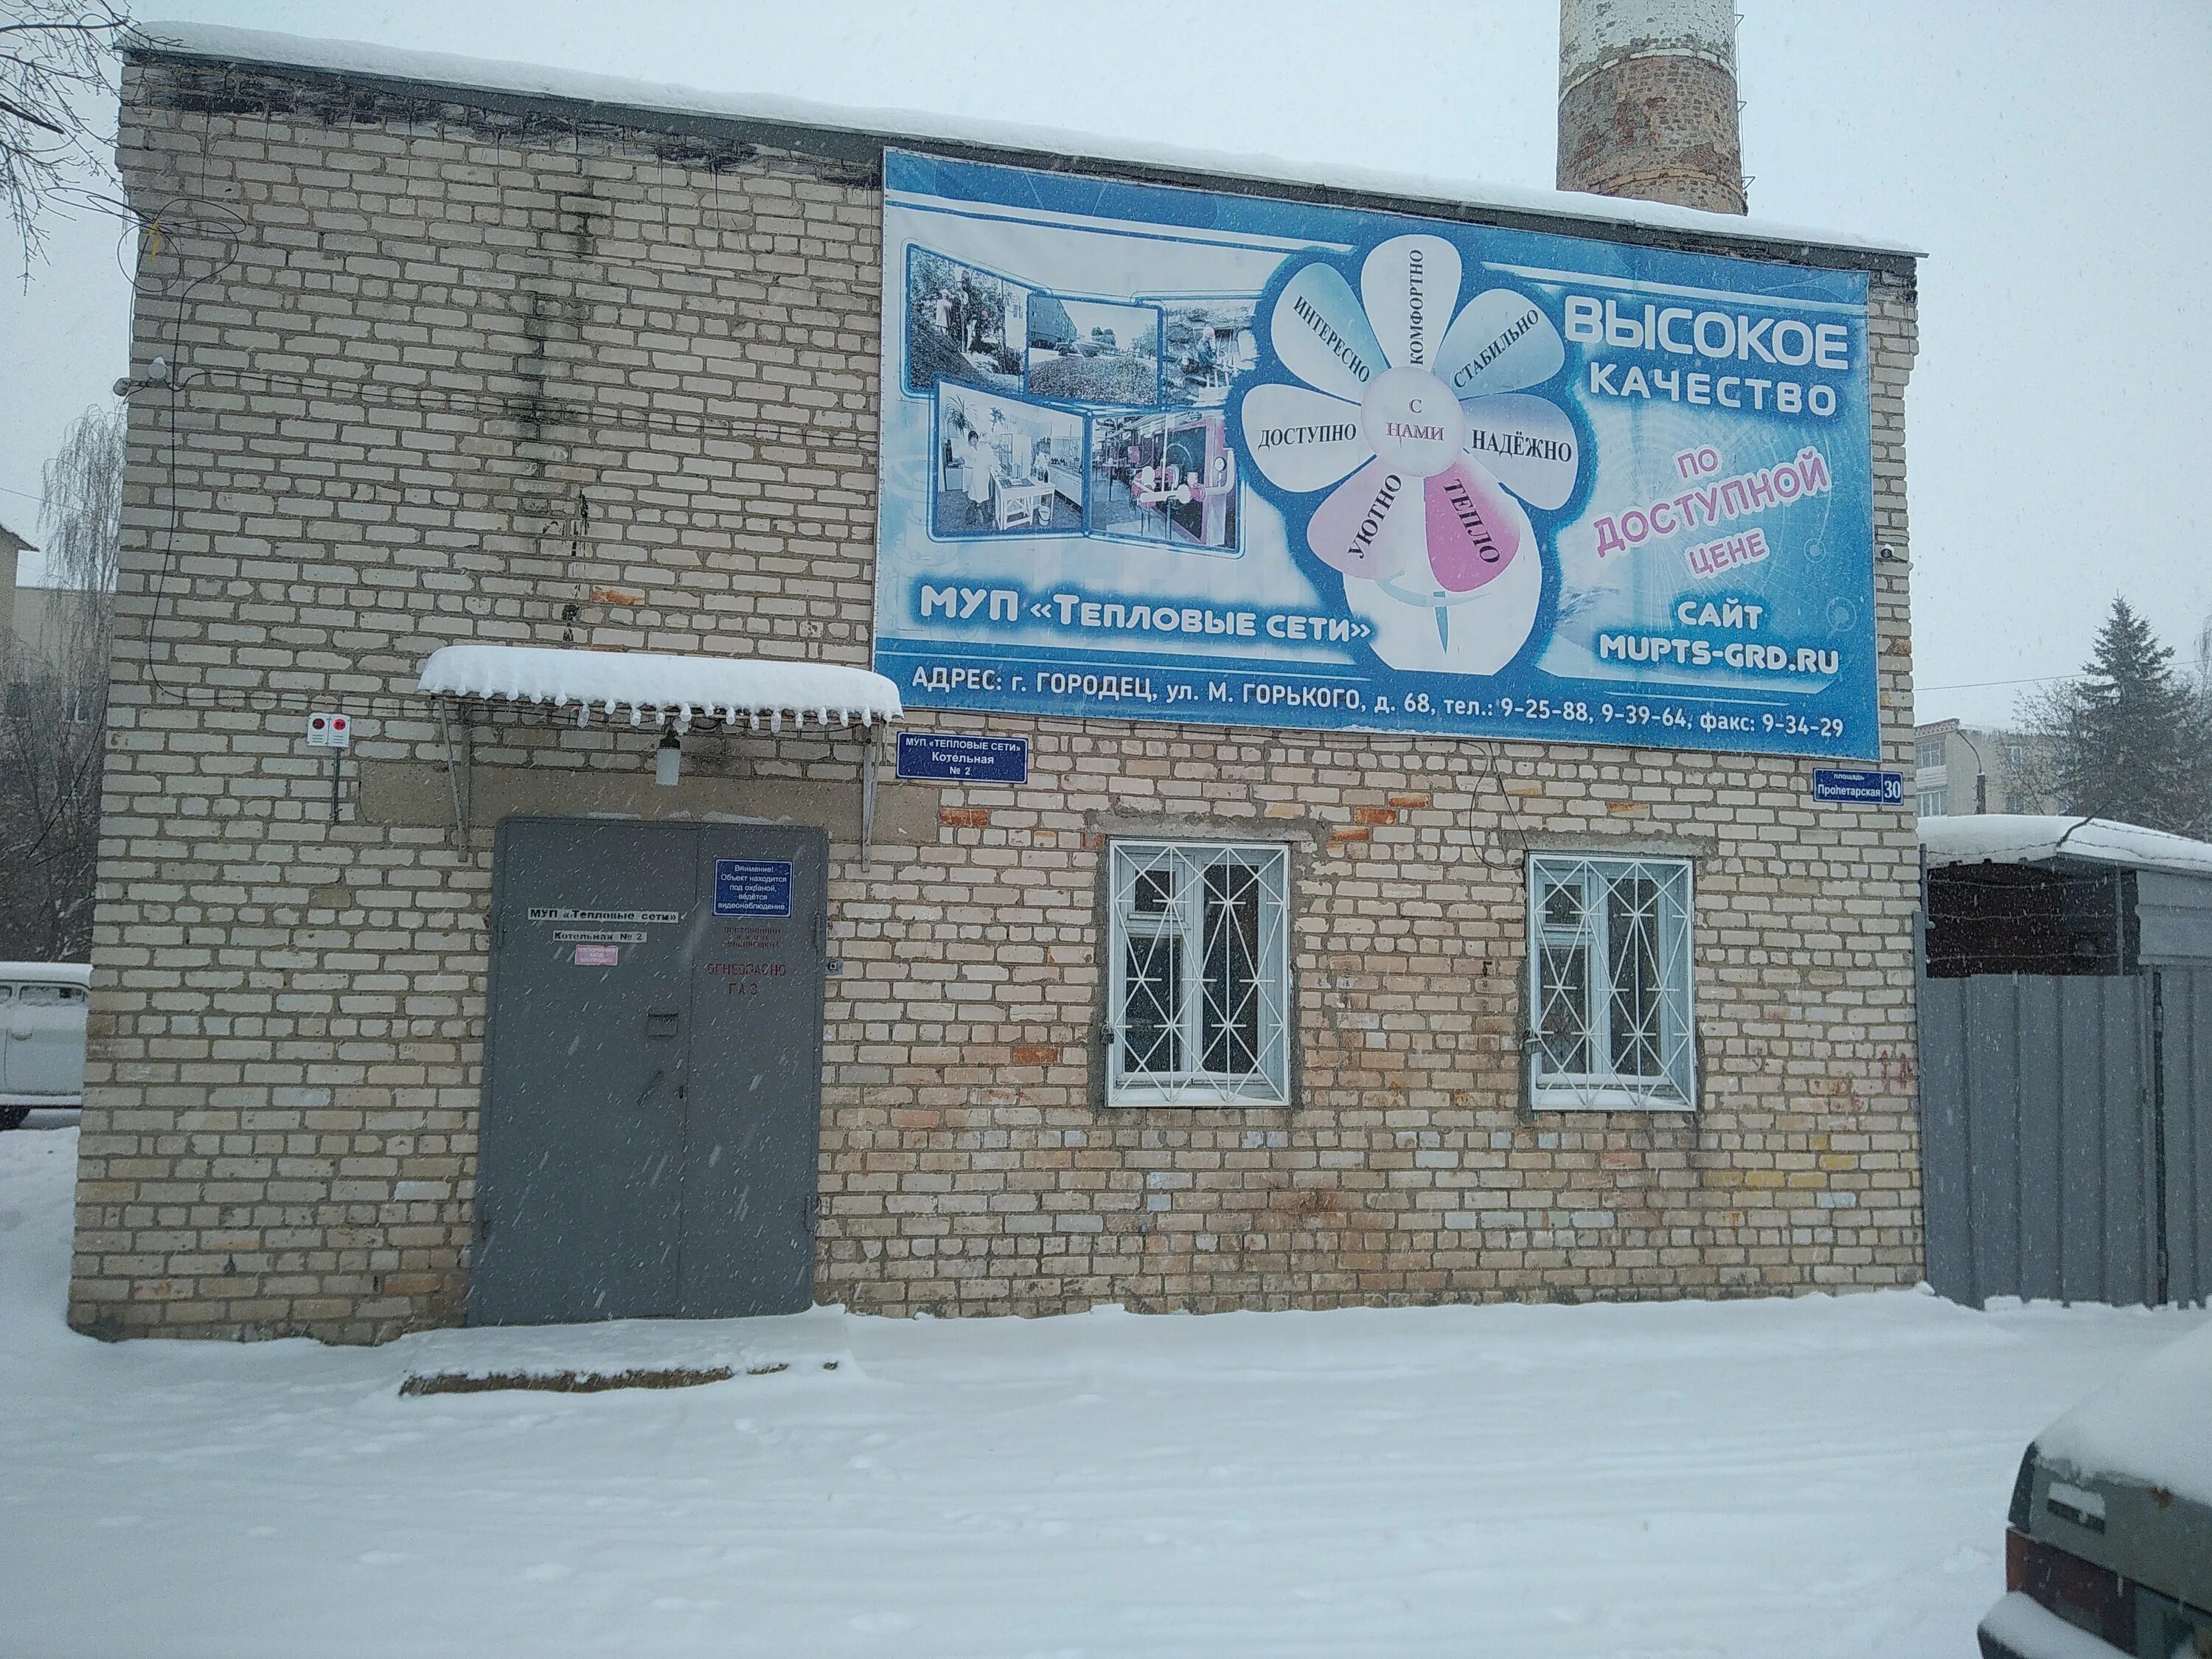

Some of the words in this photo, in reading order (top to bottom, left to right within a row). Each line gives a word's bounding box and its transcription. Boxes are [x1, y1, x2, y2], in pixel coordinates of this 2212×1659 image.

[1410, 249, 1424, 365] КОМФОРТНО
[1293, 295, 1370, 383] ИНТЕРЕСНО
[1565, 295, 1848, 370] ВЫСОКОЕ
[1454, 309, 1540, 389] СТАБИЛЬНО
[1589, 361, 1837, 416] КАЧЕСТВО
[1409, 399, 1422, 414] С
[1257, 423, 1357, 451] ДОСТУПНО
[1386, 422, 1444, 442] НАМИ
[1472, 430, 1572, 463] НАДЁЖНО
[1677, 448, 1719, 479] ПО
[1347, 474, 1402, 559] УЮТНО
[1593, 450, 1828, 558] ДОСТУПНОЙ
[1443, 478, 1500, 564] ТЕПЛО
[1689, 532, 1767, 574] ЦЕНЕ
[920, 585, 1019, 622] МУП
[1677, 598, 1763, 630] САЙТ
[1599, 635, 1839, 674] MUPTS-GRD.RU
[912, 666, 1002, 693] АДРЕС:
[1012, 676, 1026, 692] г.
[1037, 672, 1158, 703] ГОРОДЕЦ,
[1166, 684, 1199, 703] ул.
[1208, 681, 1234, 702] М.
[1243, 683, 1366, 712] ГОРЬКОГО,
[1374, 695, 1396, 714] д.
[1404, 693, 1436, 716] 68,
[1444, 699, 1493, 717] тел.:
[1500, 698, 1594, 724] 9-25-88,
[1601, 703, 1692, 730] 9-39-64,
[1700, 712, 1755, 733] факс:
[1762, 713, 1844, 737] 9-34-29
[905, 737, 927, 747] МУП
[929, 739, 989, 751] «ТЕПЛОВЫЕ
[991, 742, 1021, 752] СЕТИ»
[932, 751, 995, 765] Котельная
[950, 766, 961, 775] №
[964, 767, 971, 775] 2
[1833, 773, 1865, 782] площадь
[1818, 784, 1881, 799] Пролетарская
[1884, 780, 1901, 799] 30
[720, 874, 748, 882] Объект
[734, 864, 774, 873] Внимание!
[745, 885, 777, 893] охраной,
[530, 908, 558, 919] МУП
[563, 909, 635, 920] «Тепловые
[641, 913, 677, 922] сети»
[554, 931, 613, 941] Котельная
[619, 933, 633, 941] №
[708, 962, 786, 976] ОГНЕОПАСНО
